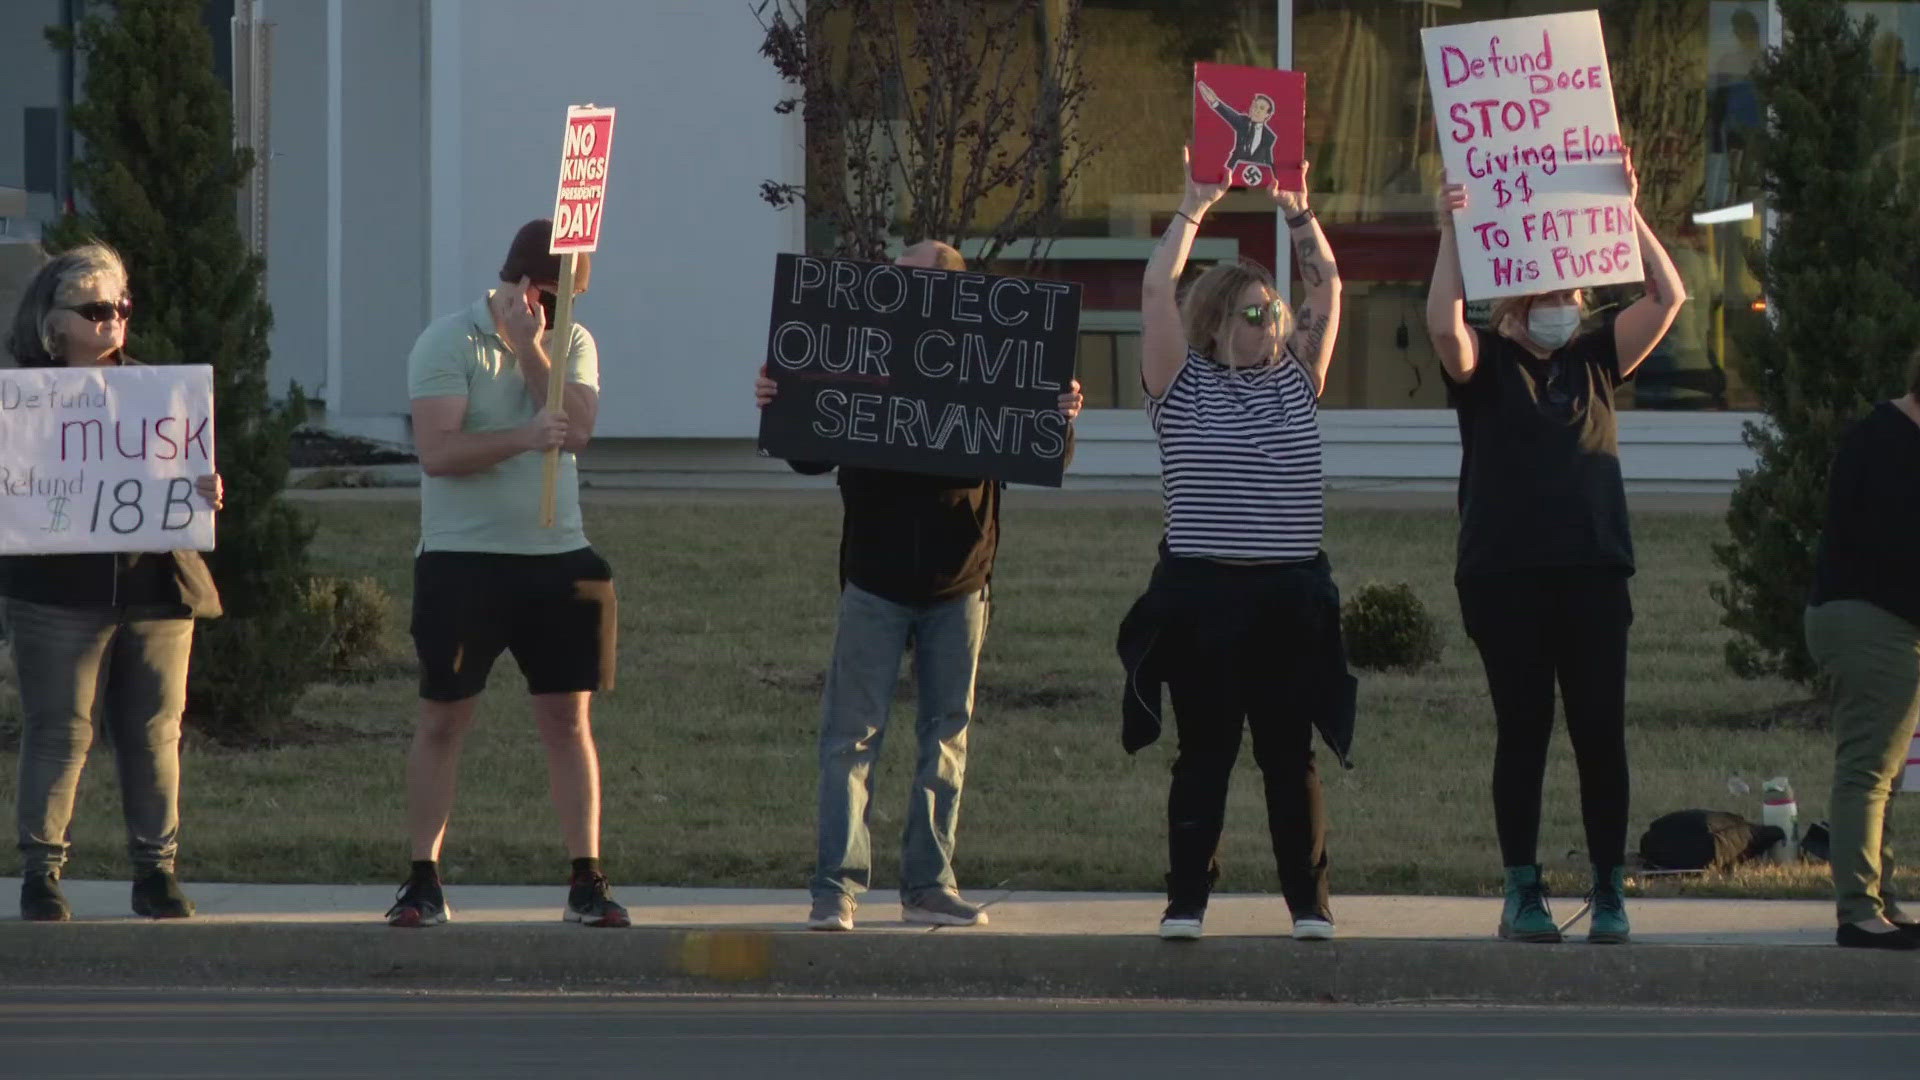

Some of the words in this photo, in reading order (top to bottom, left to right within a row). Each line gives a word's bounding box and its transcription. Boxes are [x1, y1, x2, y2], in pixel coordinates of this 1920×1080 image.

[1440, 29, 1553, 88] Defund
[1527, 66, 1602, 95] DOGE
[567, 123, 596, 157] NO
[1449, 98, 1551, 144] STOP
[563, 157, 605, 181] KINGS
[1466, 144, 1557, 178] Giving
[1563, 125, 1623, 163] Elon
[1492, 171, 1534, 209] $$
[556, 203, 599, 239] DAY
[1522, 206, 1634, 243] FATTEN
[1492, 257, 1540, 287] His
[1551, 242, 1632, 281] Purse
[792, 256, 1070, 332] PROTECT
[772, 320, 893, 377] OUR
[914, 328, 1061, 391] CIVIL
[2, 380, 108, 411] Defund
[812, 388, 1067, 459] SERVANTS
[161, 477, 194, 531] B
